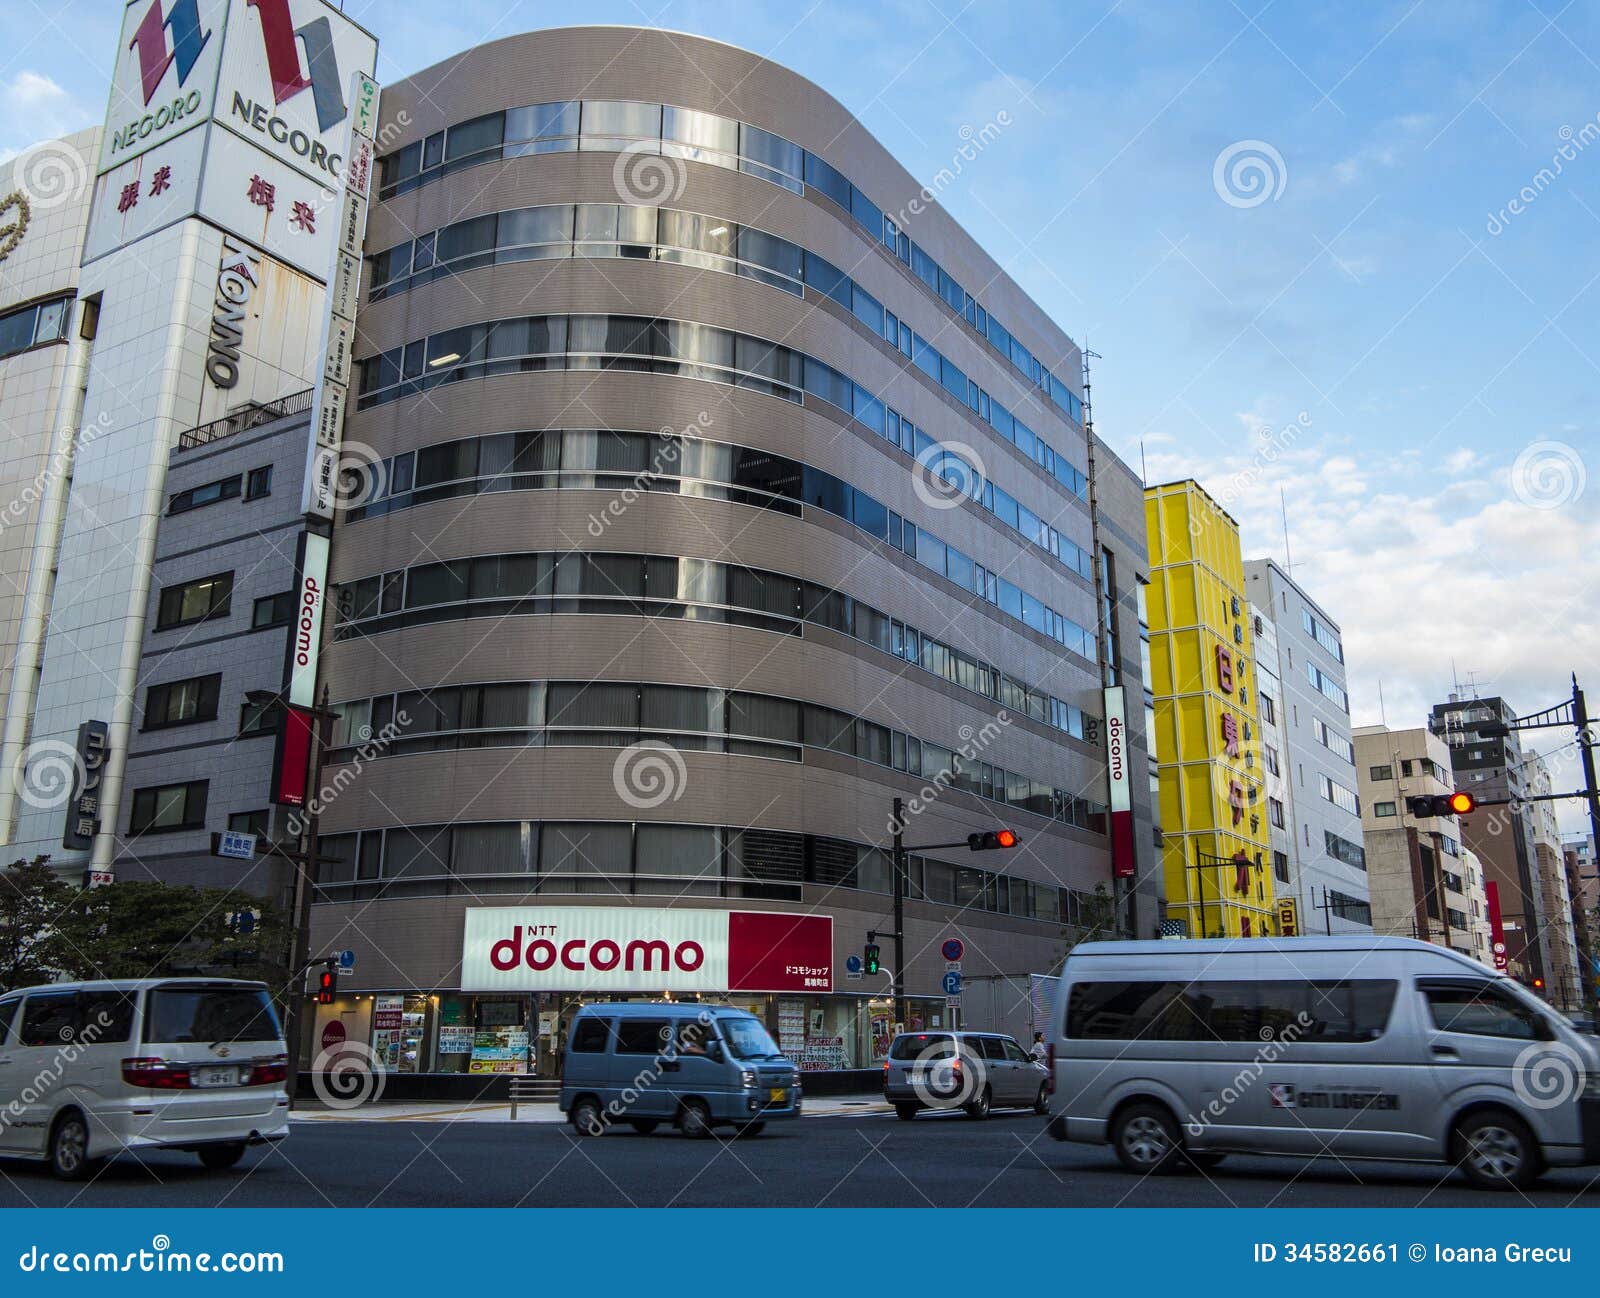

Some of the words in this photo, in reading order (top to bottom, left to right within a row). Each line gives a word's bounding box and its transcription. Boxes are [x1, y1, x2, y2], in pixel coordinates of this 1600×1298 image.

[112, 89, 201, 154] NEGORO
[246, 173, 316, 234] 根来
[207, 235, 261, 390] KONNO
[297, 577, 320, 666] docomo
[1109, 717, 1122, 780] docomo
[490, 926, 704, 972] docomo
[528, 926, 557, 936] NTT
[785, 966, 829, 976] ドコモショップ
[946, 977, 956, 992] P
